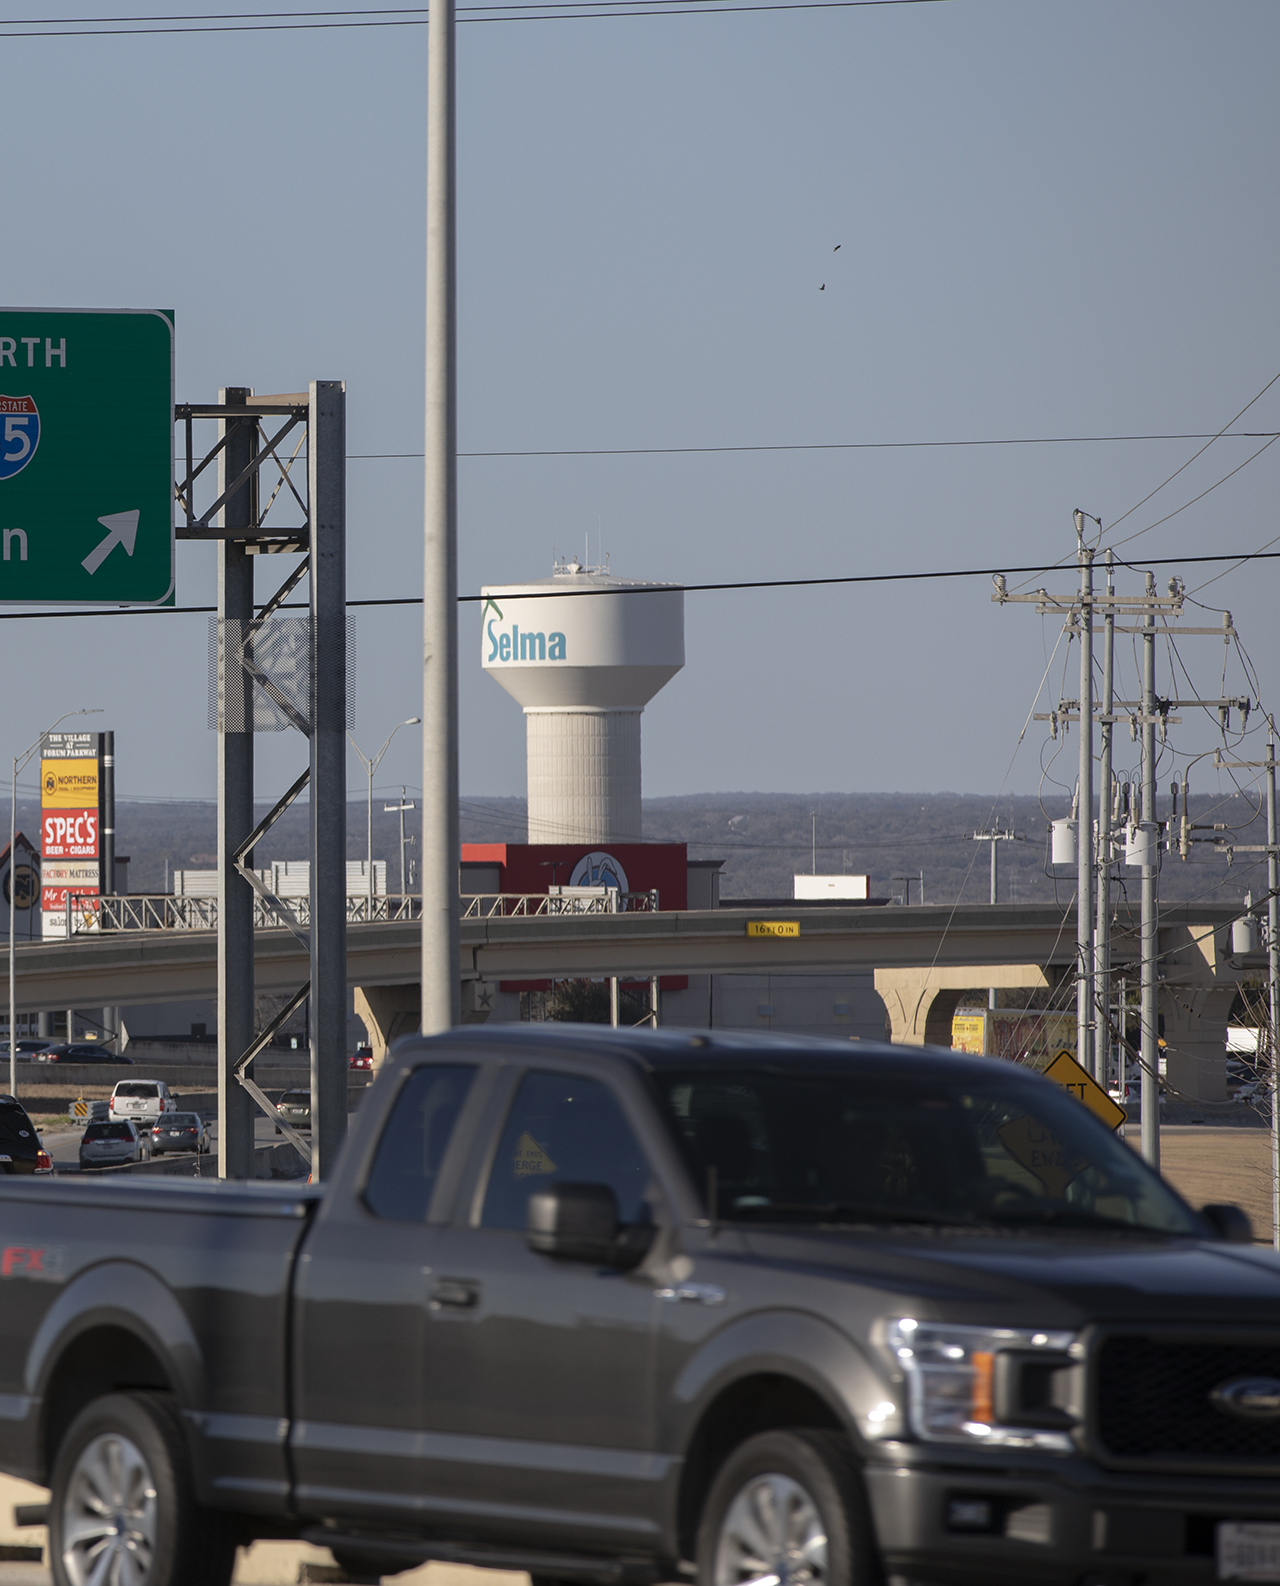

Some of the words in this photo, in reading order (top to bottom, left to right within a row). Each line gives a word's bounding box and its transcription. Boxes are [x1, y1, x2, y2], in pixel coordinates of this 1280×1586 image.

[487, 619, 567, 662] Selma
[49, 734, 62, 742] THE
[63, 734, 91, 742] VILLAGE
[43, 749, 66, 757] FORUM
[66, 749, 96, 757] PARKWAY
[58, 775, 97, 785] NORTHERN
[45, 811, 96, 844] SPEC'S
[45, 845, 64, 855] BEER
[69, 845, 95, 855] CIGARS
[42, 869, 68, 879] FACTORY
[69, 869, 99, 879] MATTRESS
[44, 888, 58, 901] Mr
[755, 925, 766, 934] 16
[777, 925, 784, 934] 0
